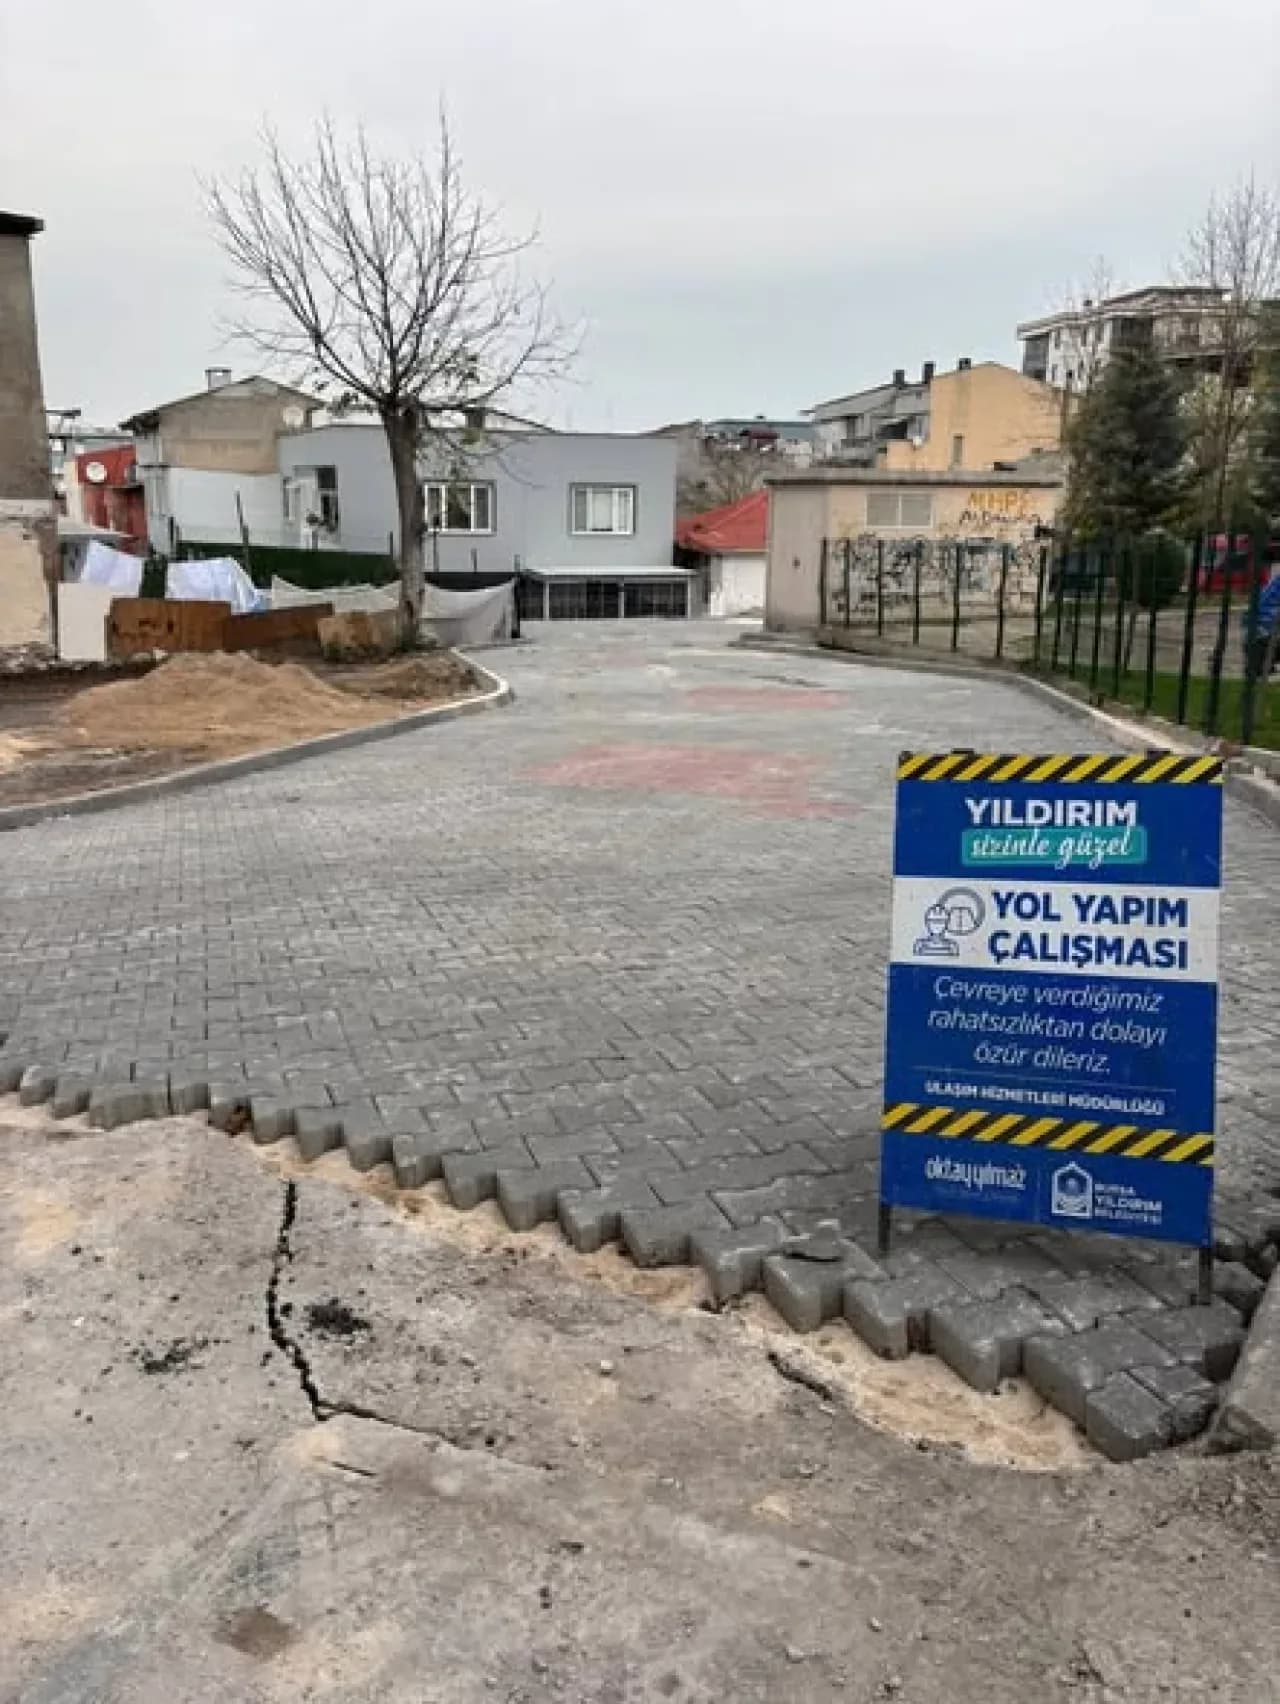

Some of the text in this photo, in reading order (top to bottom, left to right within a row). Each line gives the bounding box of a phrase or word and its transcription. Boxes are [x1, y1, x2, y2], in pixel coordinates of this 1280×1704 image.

[966, 798, 1137, 827] YILDIRIM
[971, 827, 1131, 869] sizinle güzel
[991, 891, 1188, 927] YOL YAPIM
[988, 931, 1188, 969] ÇALIŞMASI
[934, 975, 1164, 1012] Çevreye verdiğimiz
[927, 1009, 1167, 1048] rahatsızlıktan dolayı
[974, 1041, 1111, 1073] özür dileriz.
